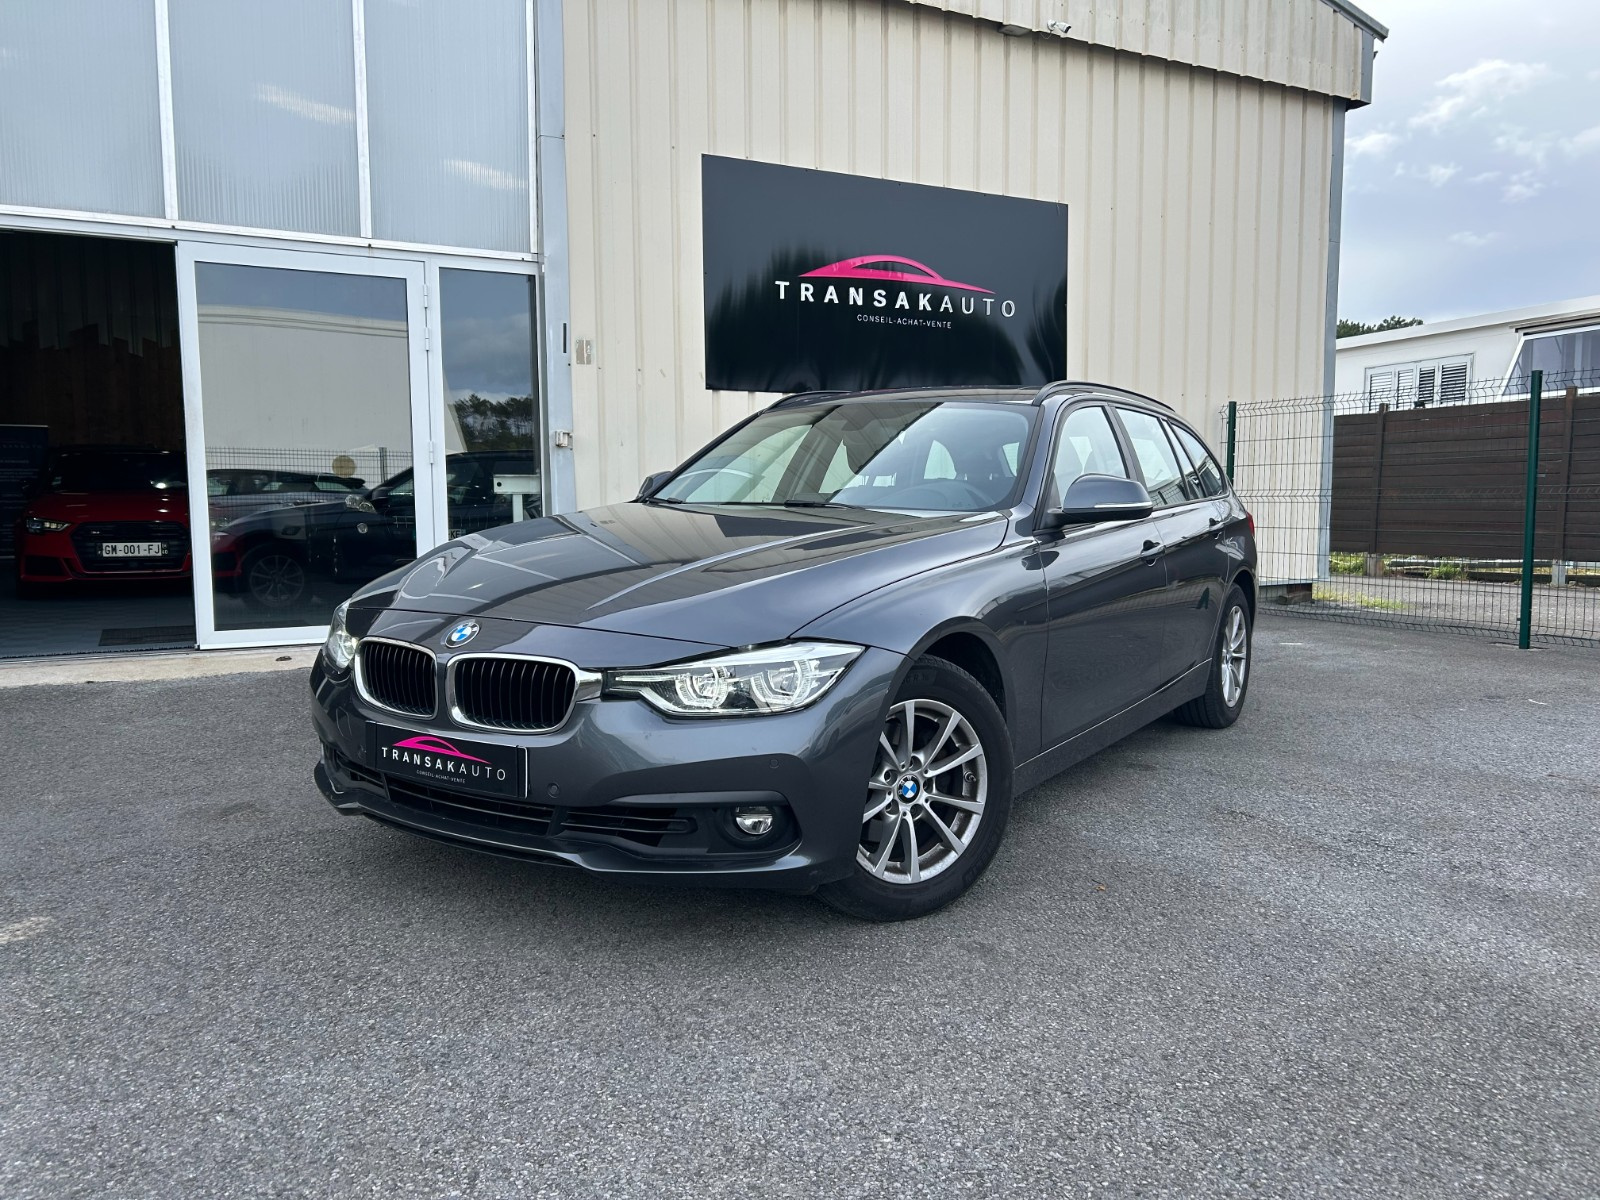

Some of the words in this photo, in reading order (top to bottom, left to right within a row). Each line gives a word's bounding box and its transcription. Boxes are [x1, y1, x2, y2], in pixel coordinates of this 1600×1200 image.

[775, 281, 1016, 317] TRANSAKAUTO
[857, 314, 952, 329] CONSEIL-ACHAT-VENTE
[104, 544, 160, 555] GM-001-FJ
[381, 746, 506, 781] TRANSAKAUTO
